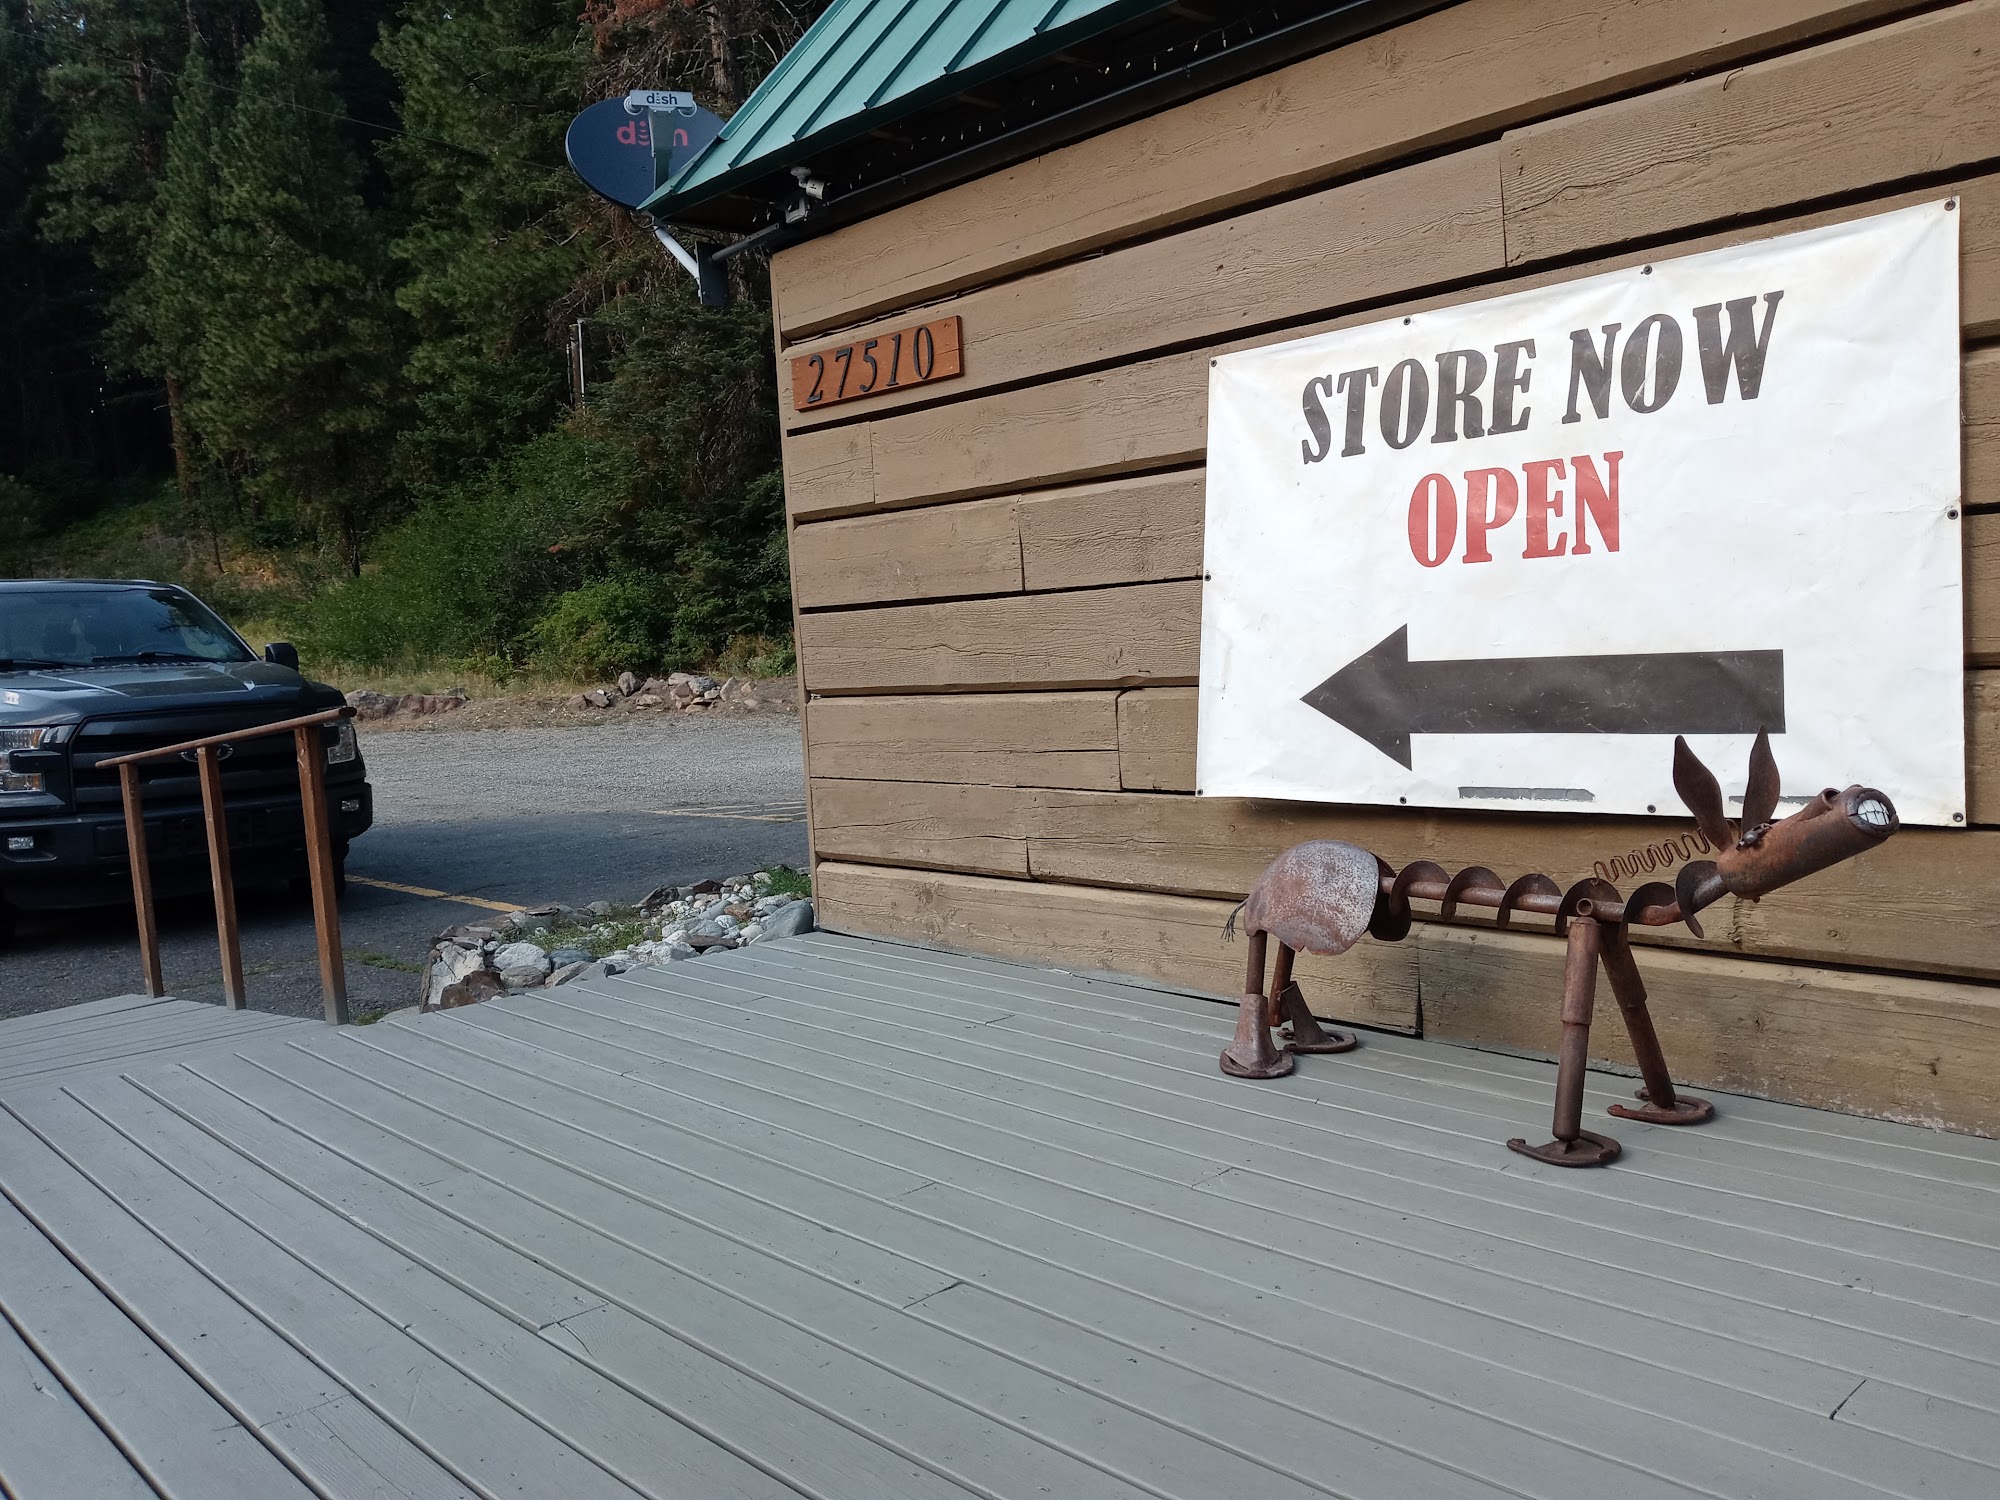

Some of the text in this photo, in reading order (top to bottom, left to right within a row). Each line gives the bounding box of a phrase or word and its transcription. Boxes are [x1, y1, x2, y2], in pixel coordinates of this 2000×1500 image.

[616, 121, 688, 147] dih
[646, 93, 678, 105] dish
[807, 325, 934, 404] 27510
[1301, 290, 1785, 465] STORE NOW
[1407, 450, 1624, 568] OPEN
